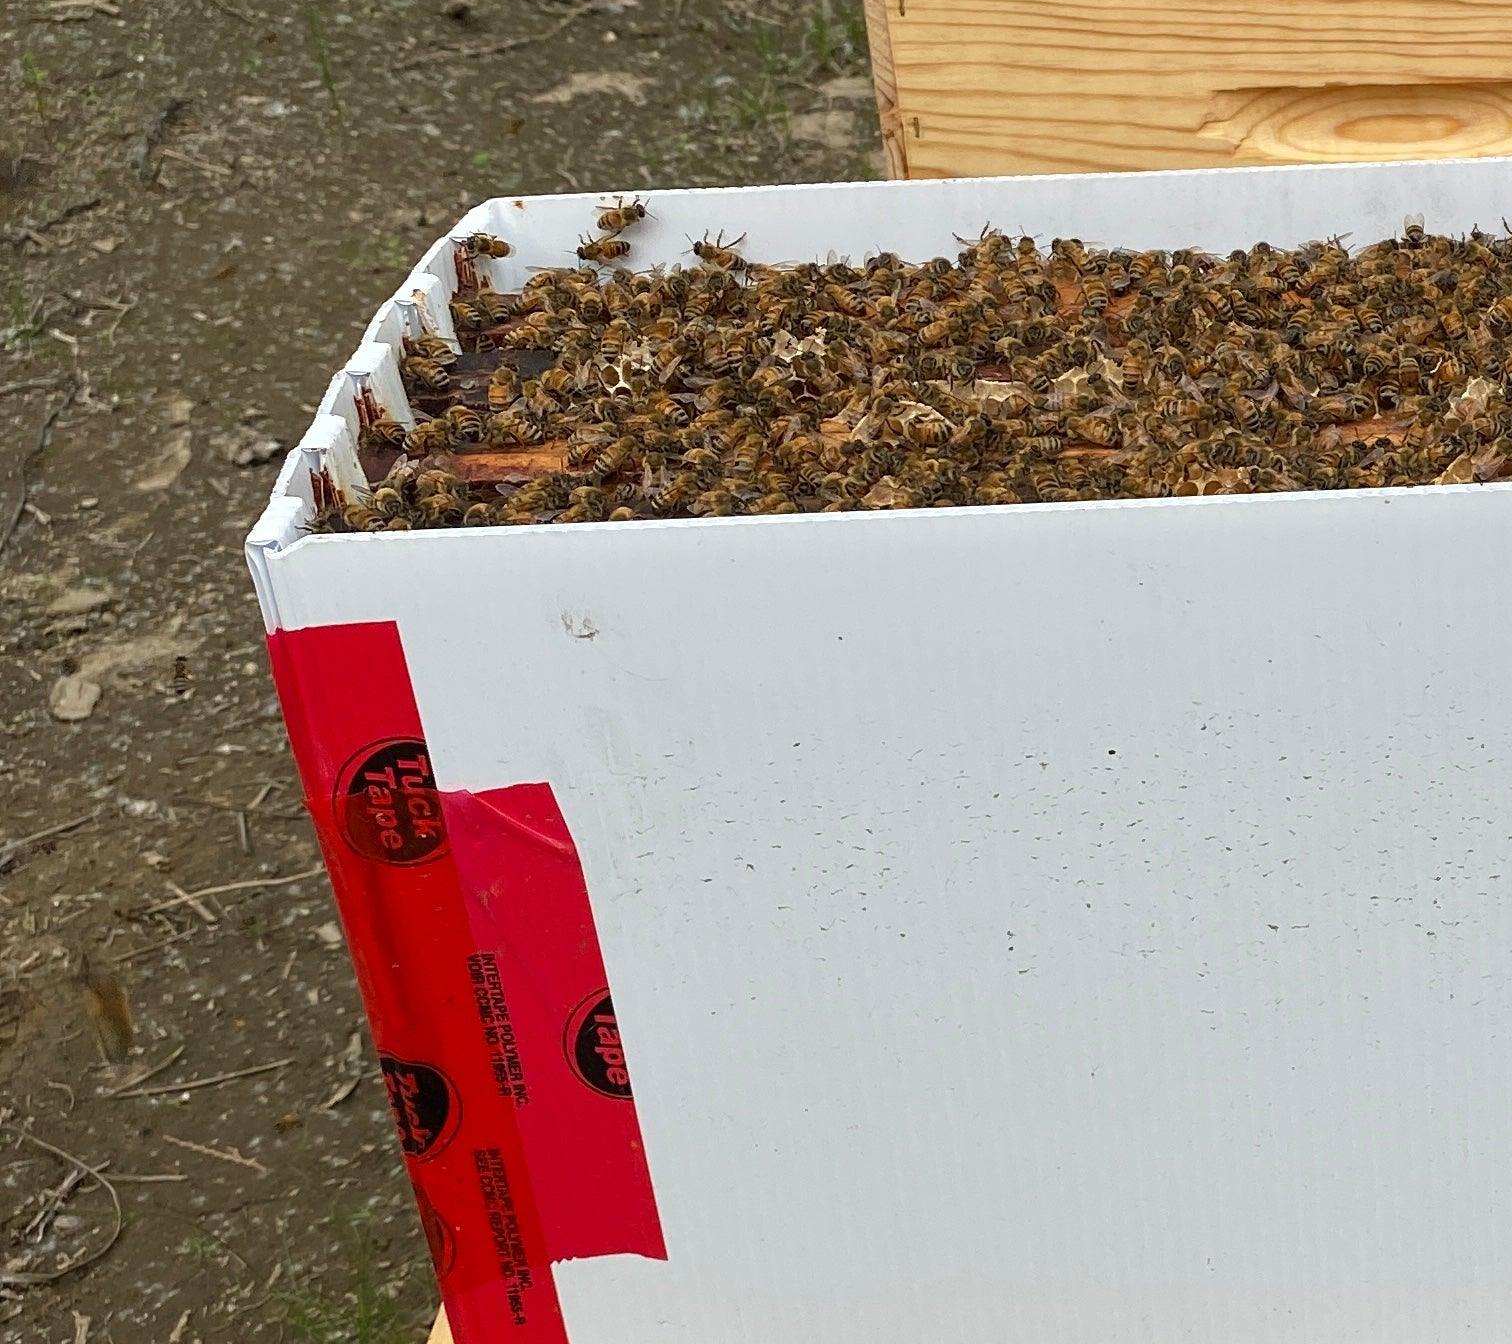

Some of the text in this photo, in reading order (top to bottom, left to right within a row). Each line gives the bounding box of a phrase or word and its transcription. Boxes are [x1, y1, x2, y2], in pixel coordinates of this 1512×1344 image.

[364, 766, 405, 850] Tape
[397, 754, 442, 839] Tuck
[467, 954, 485, 985] VOIR
[474, 987, 496, 1026] CCMC
[481, 953, 511, 1024] INTERTAPE
[501, 1024, 524, 1082] POLYMER
[485, 1027, 500, 1046] NO.
